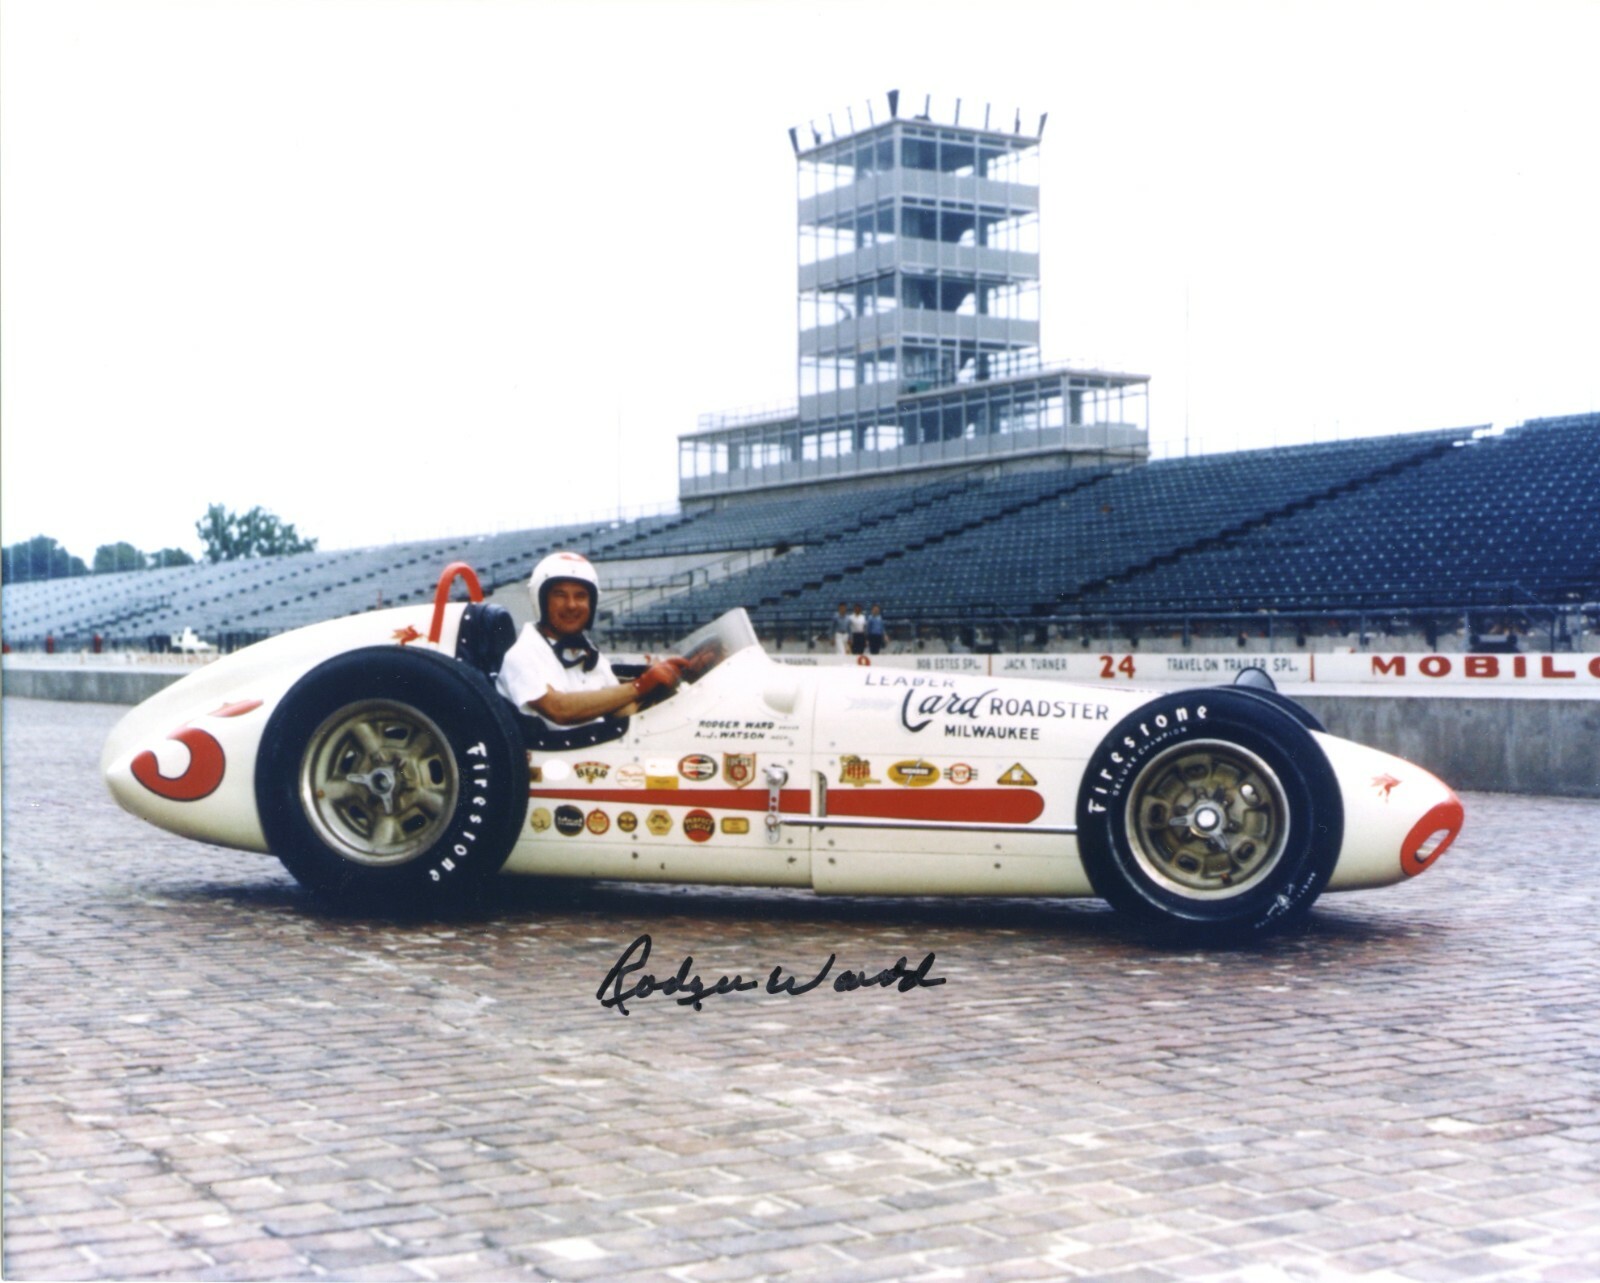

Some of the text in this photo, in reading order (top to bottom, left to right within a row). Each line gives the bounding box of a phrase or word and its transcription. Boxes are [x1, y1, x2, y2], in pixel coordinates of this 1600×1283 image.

[934, 658, 960, 670] ESTES
[1004, 658, 1068, 671] JACK TURNER
[1099, 655, 1136, 679] 24
[864, 671, 956, 688] LEADER
[901, 688, 1110, 733] Card ROADSTER
[698, 720, 740, 729] RODGER
[745, 721, 775, 730] WARD
[944, 724, 1041, 741] MILWAUKEE
[719, 731, 765, 740] WATSON
[1087, 704, 1208, 814] Firestone
[576, 768, 609, 780] BEAR
[429, 741, 489, 882] Firestone
